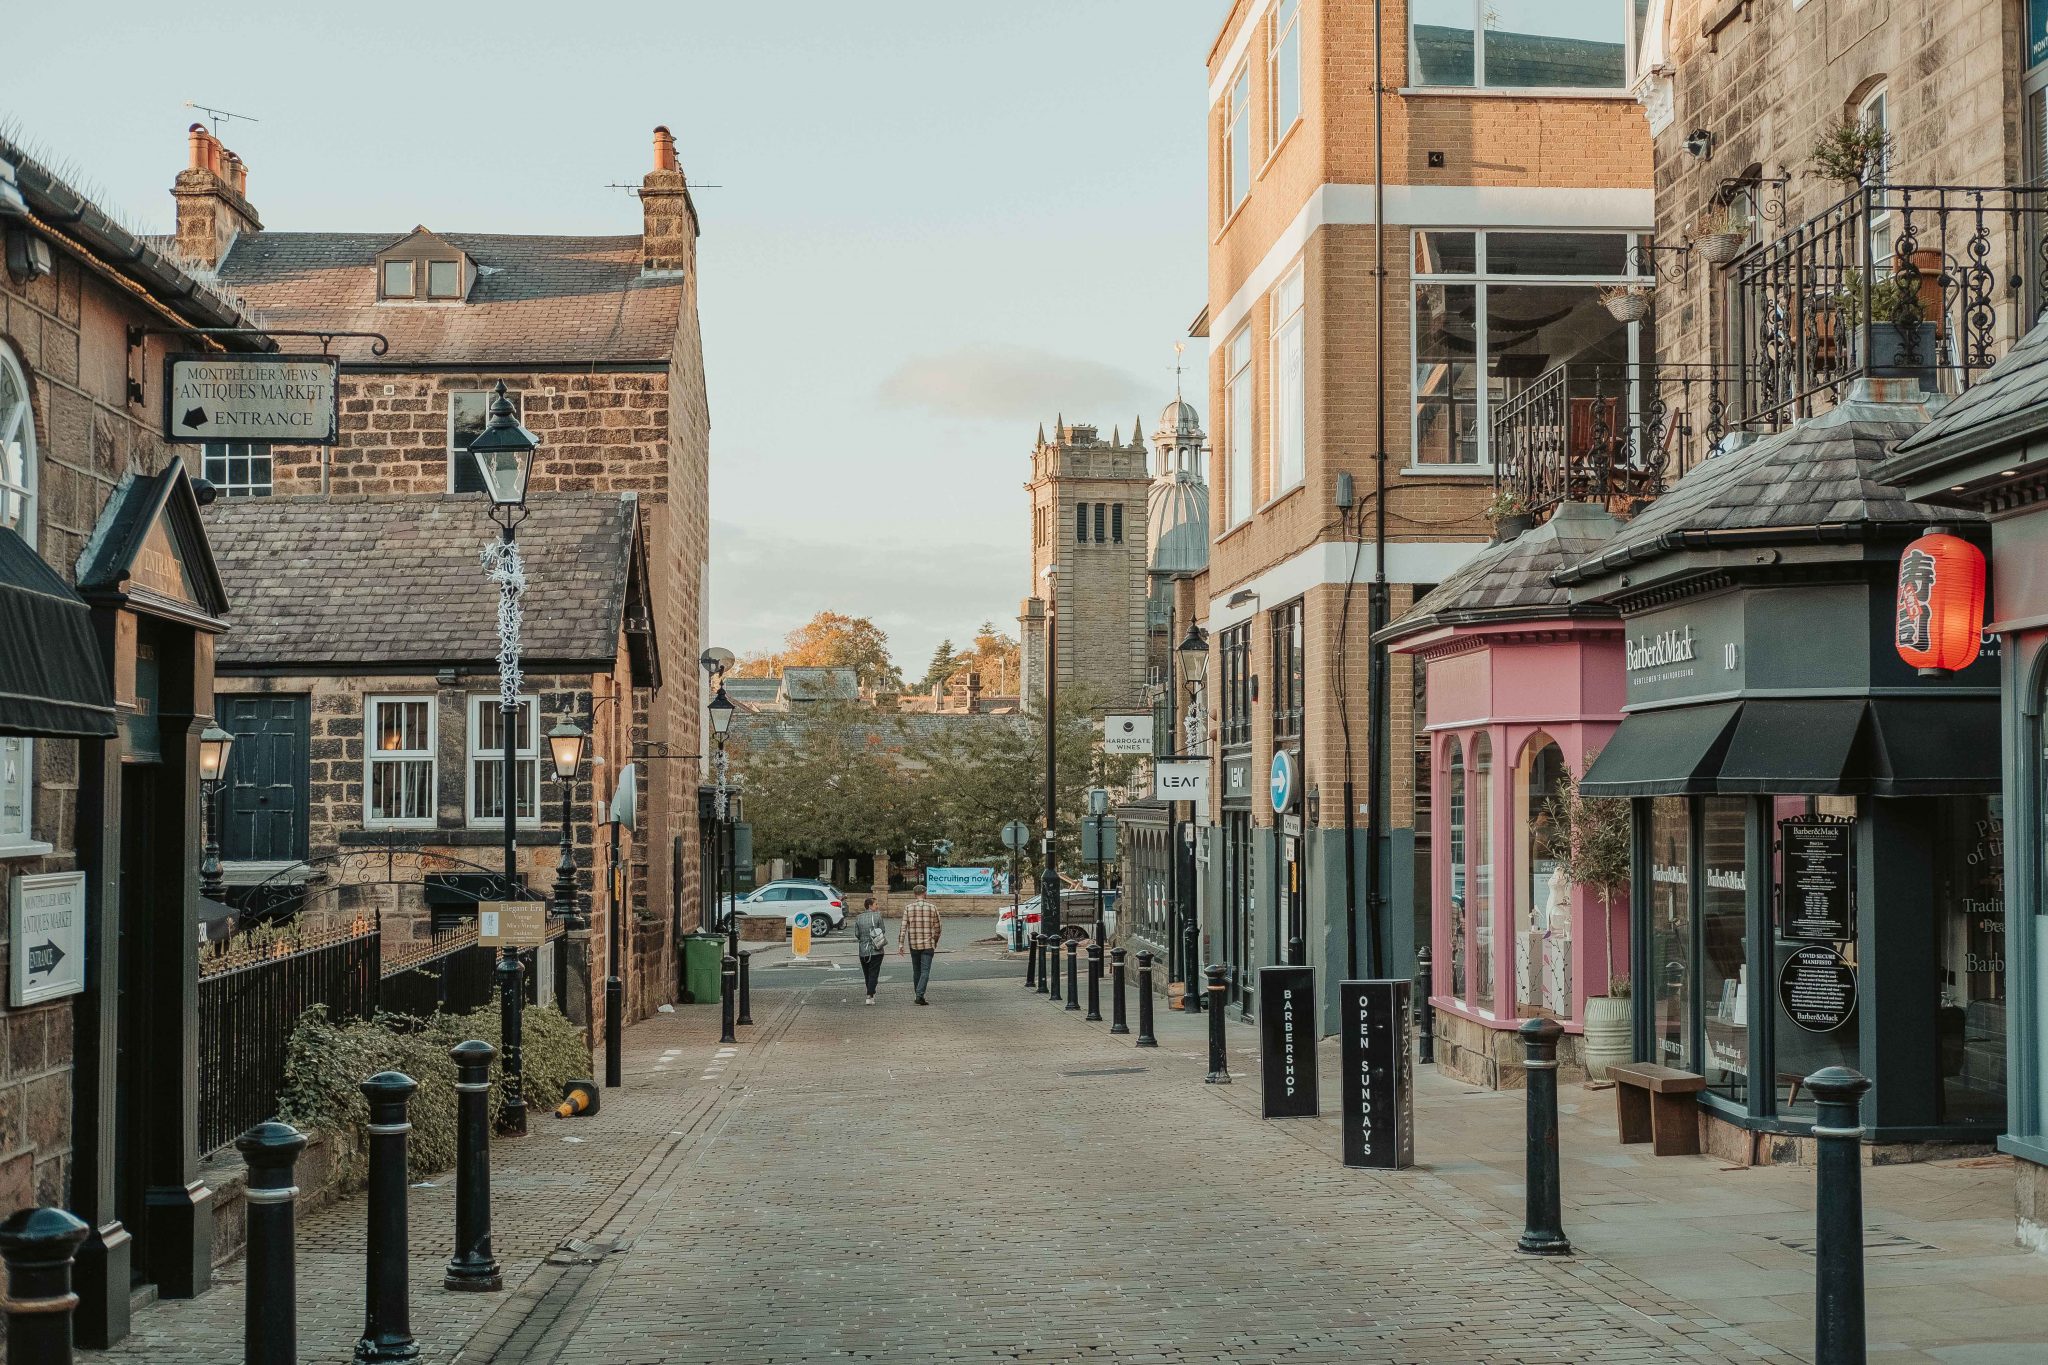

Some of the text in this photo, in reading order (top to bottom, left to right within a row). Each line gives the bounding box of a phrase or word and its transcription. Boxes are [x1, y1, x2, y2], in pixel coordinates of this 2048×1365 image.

[187, 367, 318, 381] MONTPELLIER MEWS
[180, 383, 325, 401] ANTIQUES MARKET
[214, 411, 313, 426] ENTRANCE
[1899, 549, 1936, 653] 寿司
[1626, 624, 1693, 671] Barber&Mack
[1724, 642, 1735, 670] 10
[1793, 826, 1839, 836] Barber&Mack
[928, 874, 971, 884] Recruiting
[1652, 864, 1687, 884] Barber&Mack
[1707, 868, 1746, 891] Barber&Mack
[500, 903, 543, 913] Elegant Era
[22, 910, 72, 935] ANTIQUES MARKET
[29, 948, 53, 969] ENTRANCE
[1359, 996, 1369, 1049] OPEN
[1797, 1012, 1839, 1022] Barber&Mack
[1283, 990, 1295, 1096] BARBERSHOP
[1361, 1061, 1372, 1155] SUNDAYS
